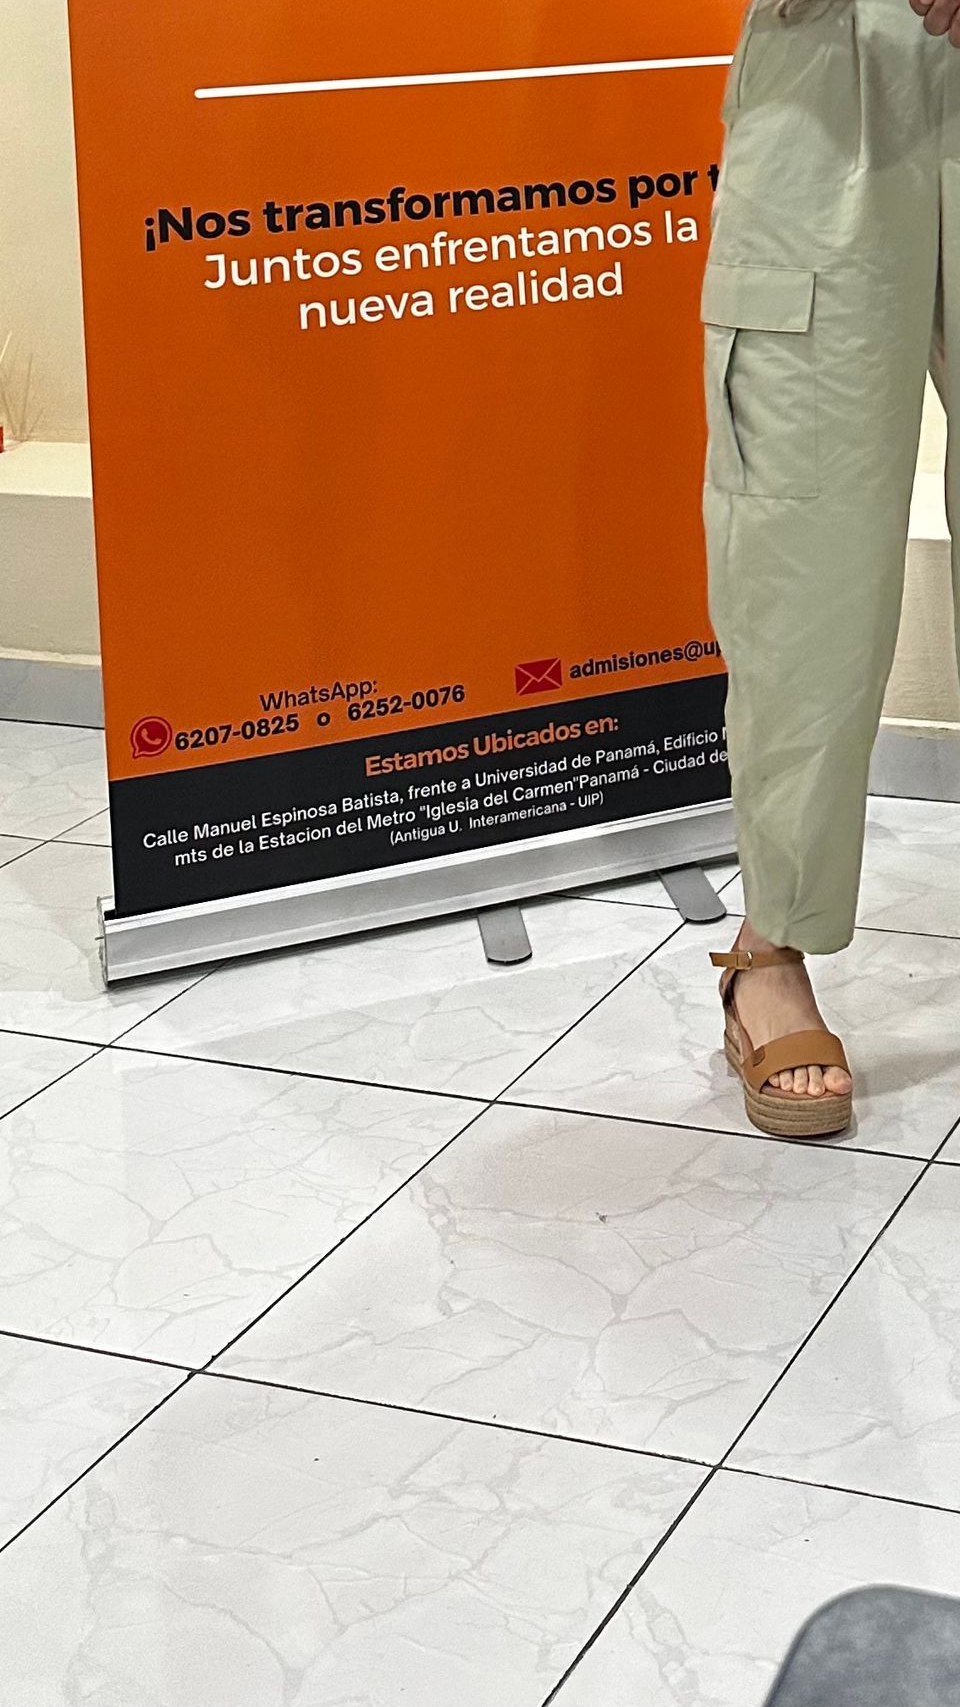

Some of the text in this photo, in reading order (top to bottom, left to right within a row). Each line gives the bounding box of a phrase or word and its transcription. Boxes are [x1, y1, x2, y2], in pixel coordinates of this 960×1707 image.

[144, 203, 251, 252] ¡Nos
[264, 176, 616, 235] transformamos
[629, 170, 698, 209] por
[204, 210, 698, 290] Juntos enfrentamos la
[300, 262, 624, 330] nueva realidad
[175, 713, 299, 751] 6207-0825
[347, 684, 465, 721] 6252-0076
[260, 679, 378, 712] WhatsApp:
[365, 716, 619, 777] Estamos Ubicados en:
[143, 827, 189, 849] Calle
[194, 814, 257, 841] Manuel
[262, 803, 337, 830] Espinosa
[342, 790, 404, 813] Batista,
[408, 776, 456, 801] frente
[461, 778, 471, 790] a
[475, 757, 567, 787] Universidad
[571, 754, 591, 771] de
[596, 740, 660, 765] Panamá,
[175, 849, 207, 866] mts
[212, 841, 234, 860] de
[239, 837, 254, 854] la
[259, 820, 331, 851] Estacion
[336, 816, 362, 836] del
[367, 809, 416, 830] Metro
[419, 791, 479, 821] "Iglesia
[483, 791, 509, 809] del
[653, 751, 706, 774] Ciudad
[709, 749, 728, 764] de
[390, 824, 446, 846] (Antigua
[469, 802, 567, 830] Interamericana
[578, 791, 604, 808] UIP)
